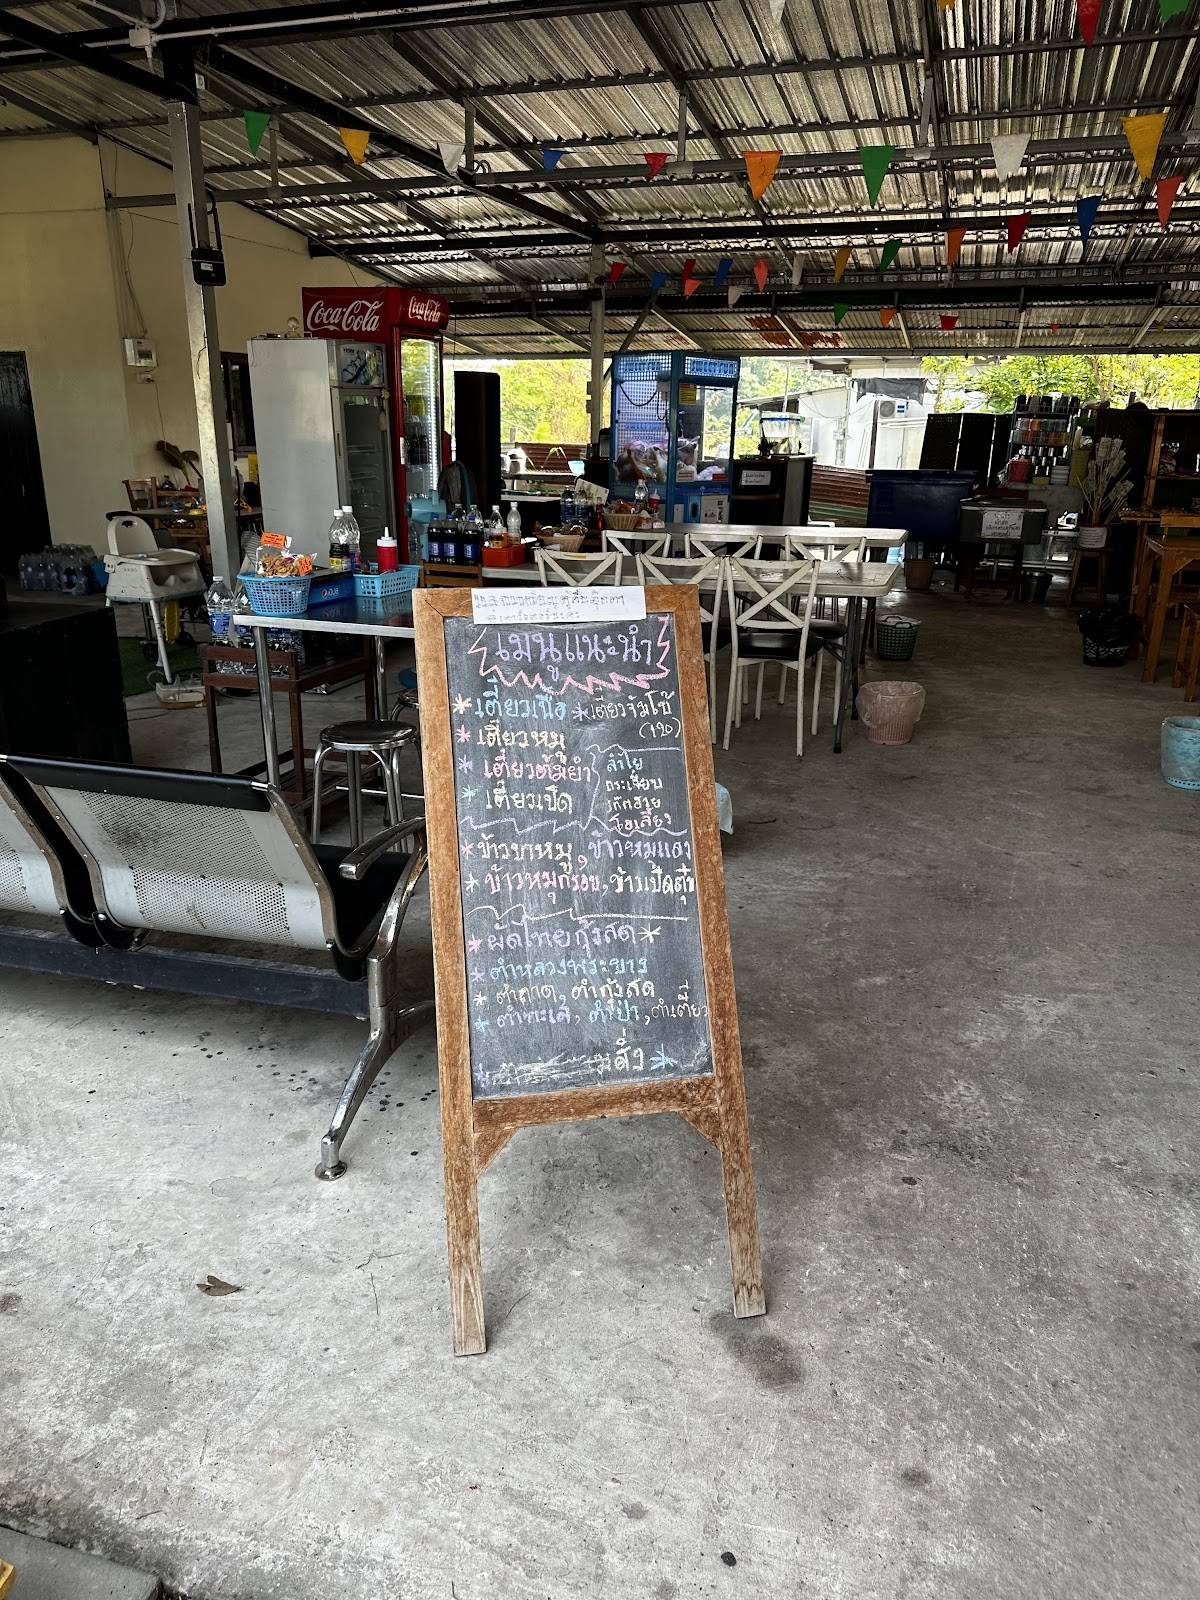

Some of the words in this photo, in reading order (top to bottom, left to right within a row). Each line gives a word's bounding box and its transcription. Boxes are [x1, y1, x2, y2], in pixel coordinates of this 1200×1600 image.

[306, 299, 385, 332] Coca-Cola
[408, 295, 441, 323] Coca-Cola
[495, 624, 652, 682] เมนูแนะนำ
